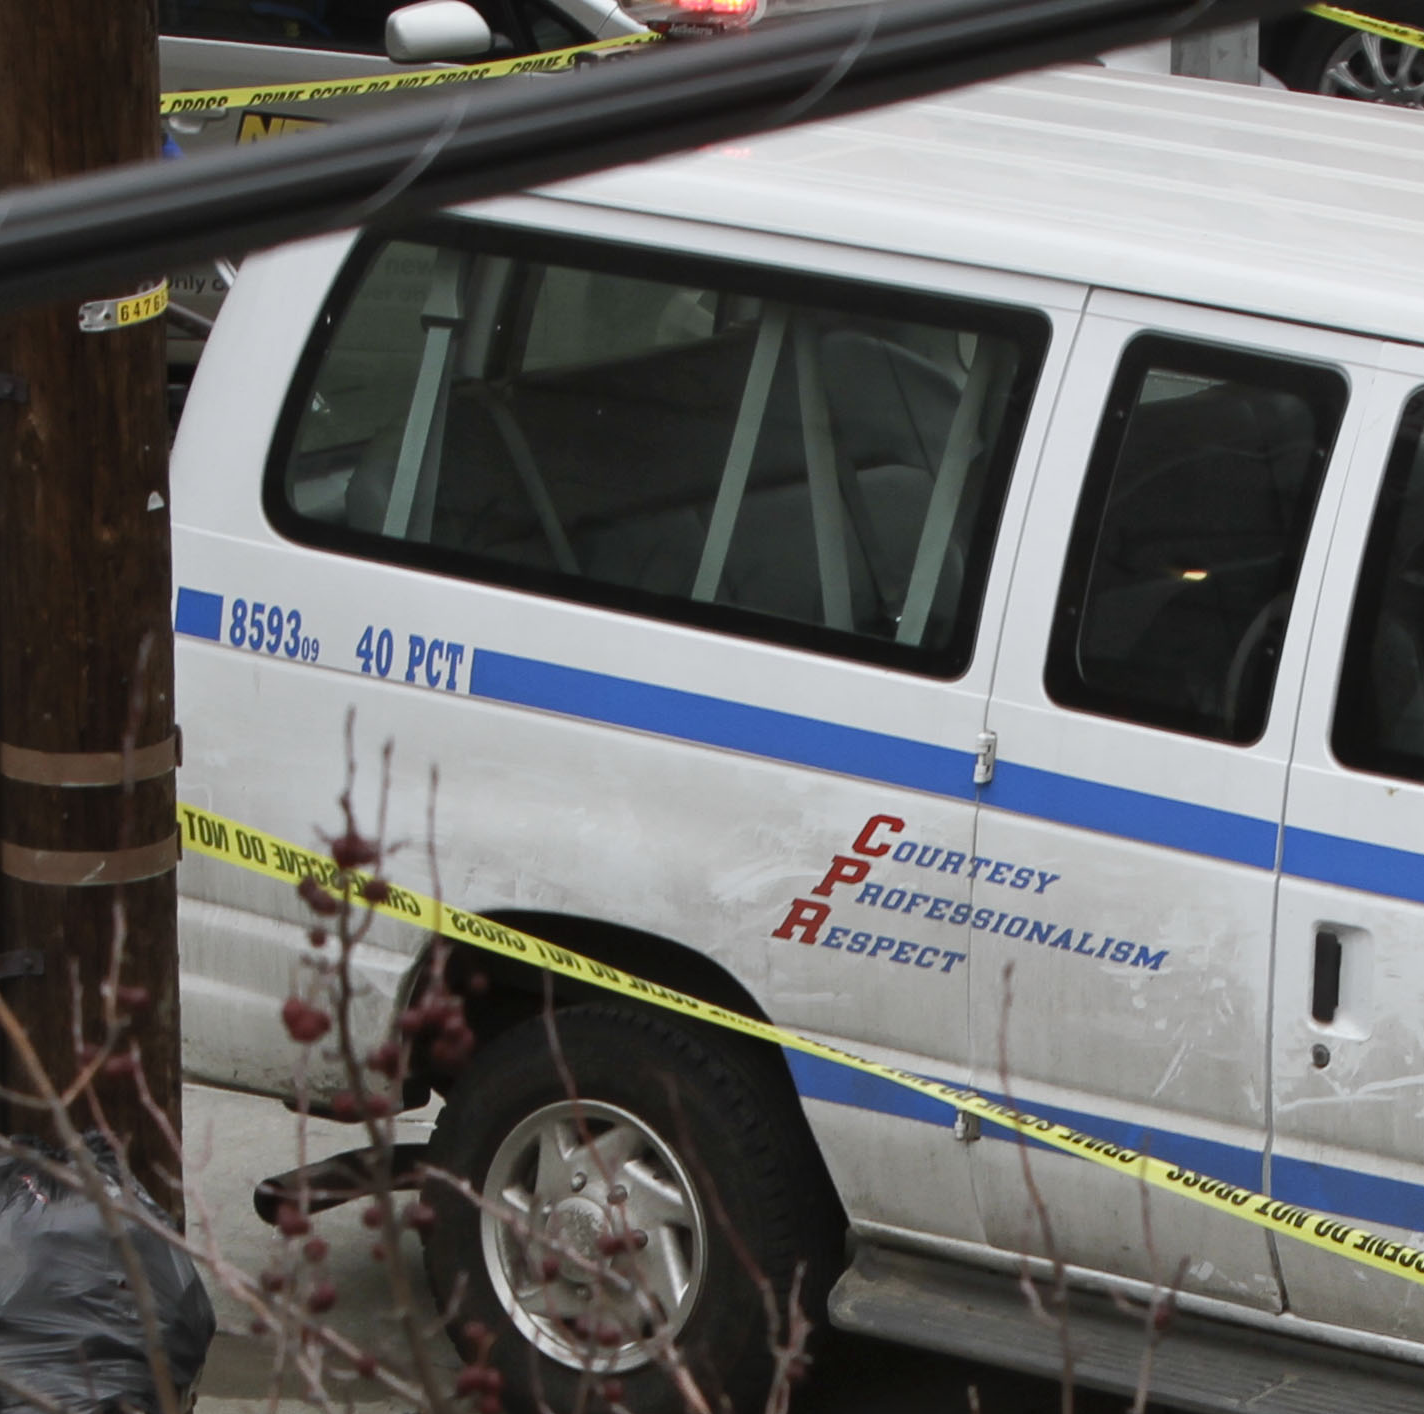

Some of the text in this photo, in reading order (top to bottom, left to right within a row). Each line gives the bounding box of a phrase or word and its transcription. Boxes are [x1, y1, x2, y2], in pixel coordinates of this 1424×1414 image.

[356, 624, 394, 678] 40
[405, 633, 465, 691] PCT
[851, 813, 1061, 894] COURTESY
[773, 898, 967, 974] RESPECT
[812, 855, 1169, 972] PROFESSIONALISM
